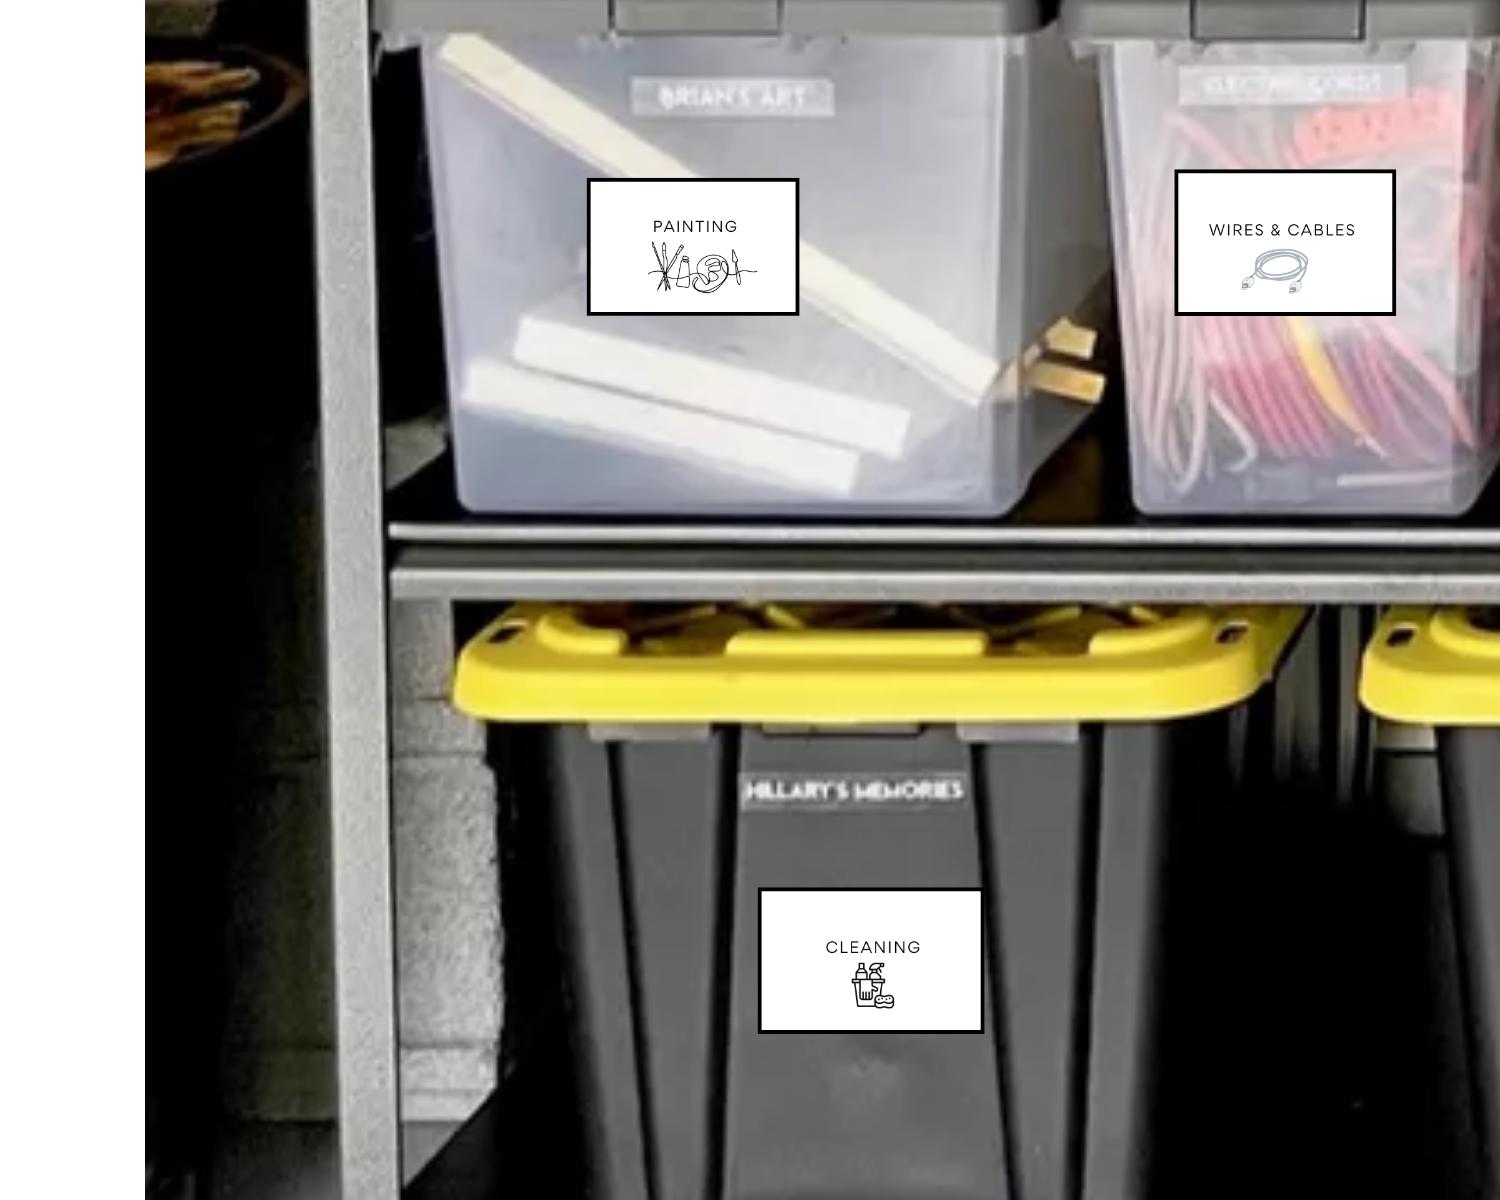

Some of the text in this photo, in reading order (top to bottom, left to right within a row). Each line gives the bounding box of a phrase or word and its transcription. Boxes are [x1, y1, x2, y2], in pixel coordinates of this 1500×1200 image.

[657, 85, 807, 108] BRIAN'S ART
[747, 779, 965, 801] HILLARY'S MEMORIES
